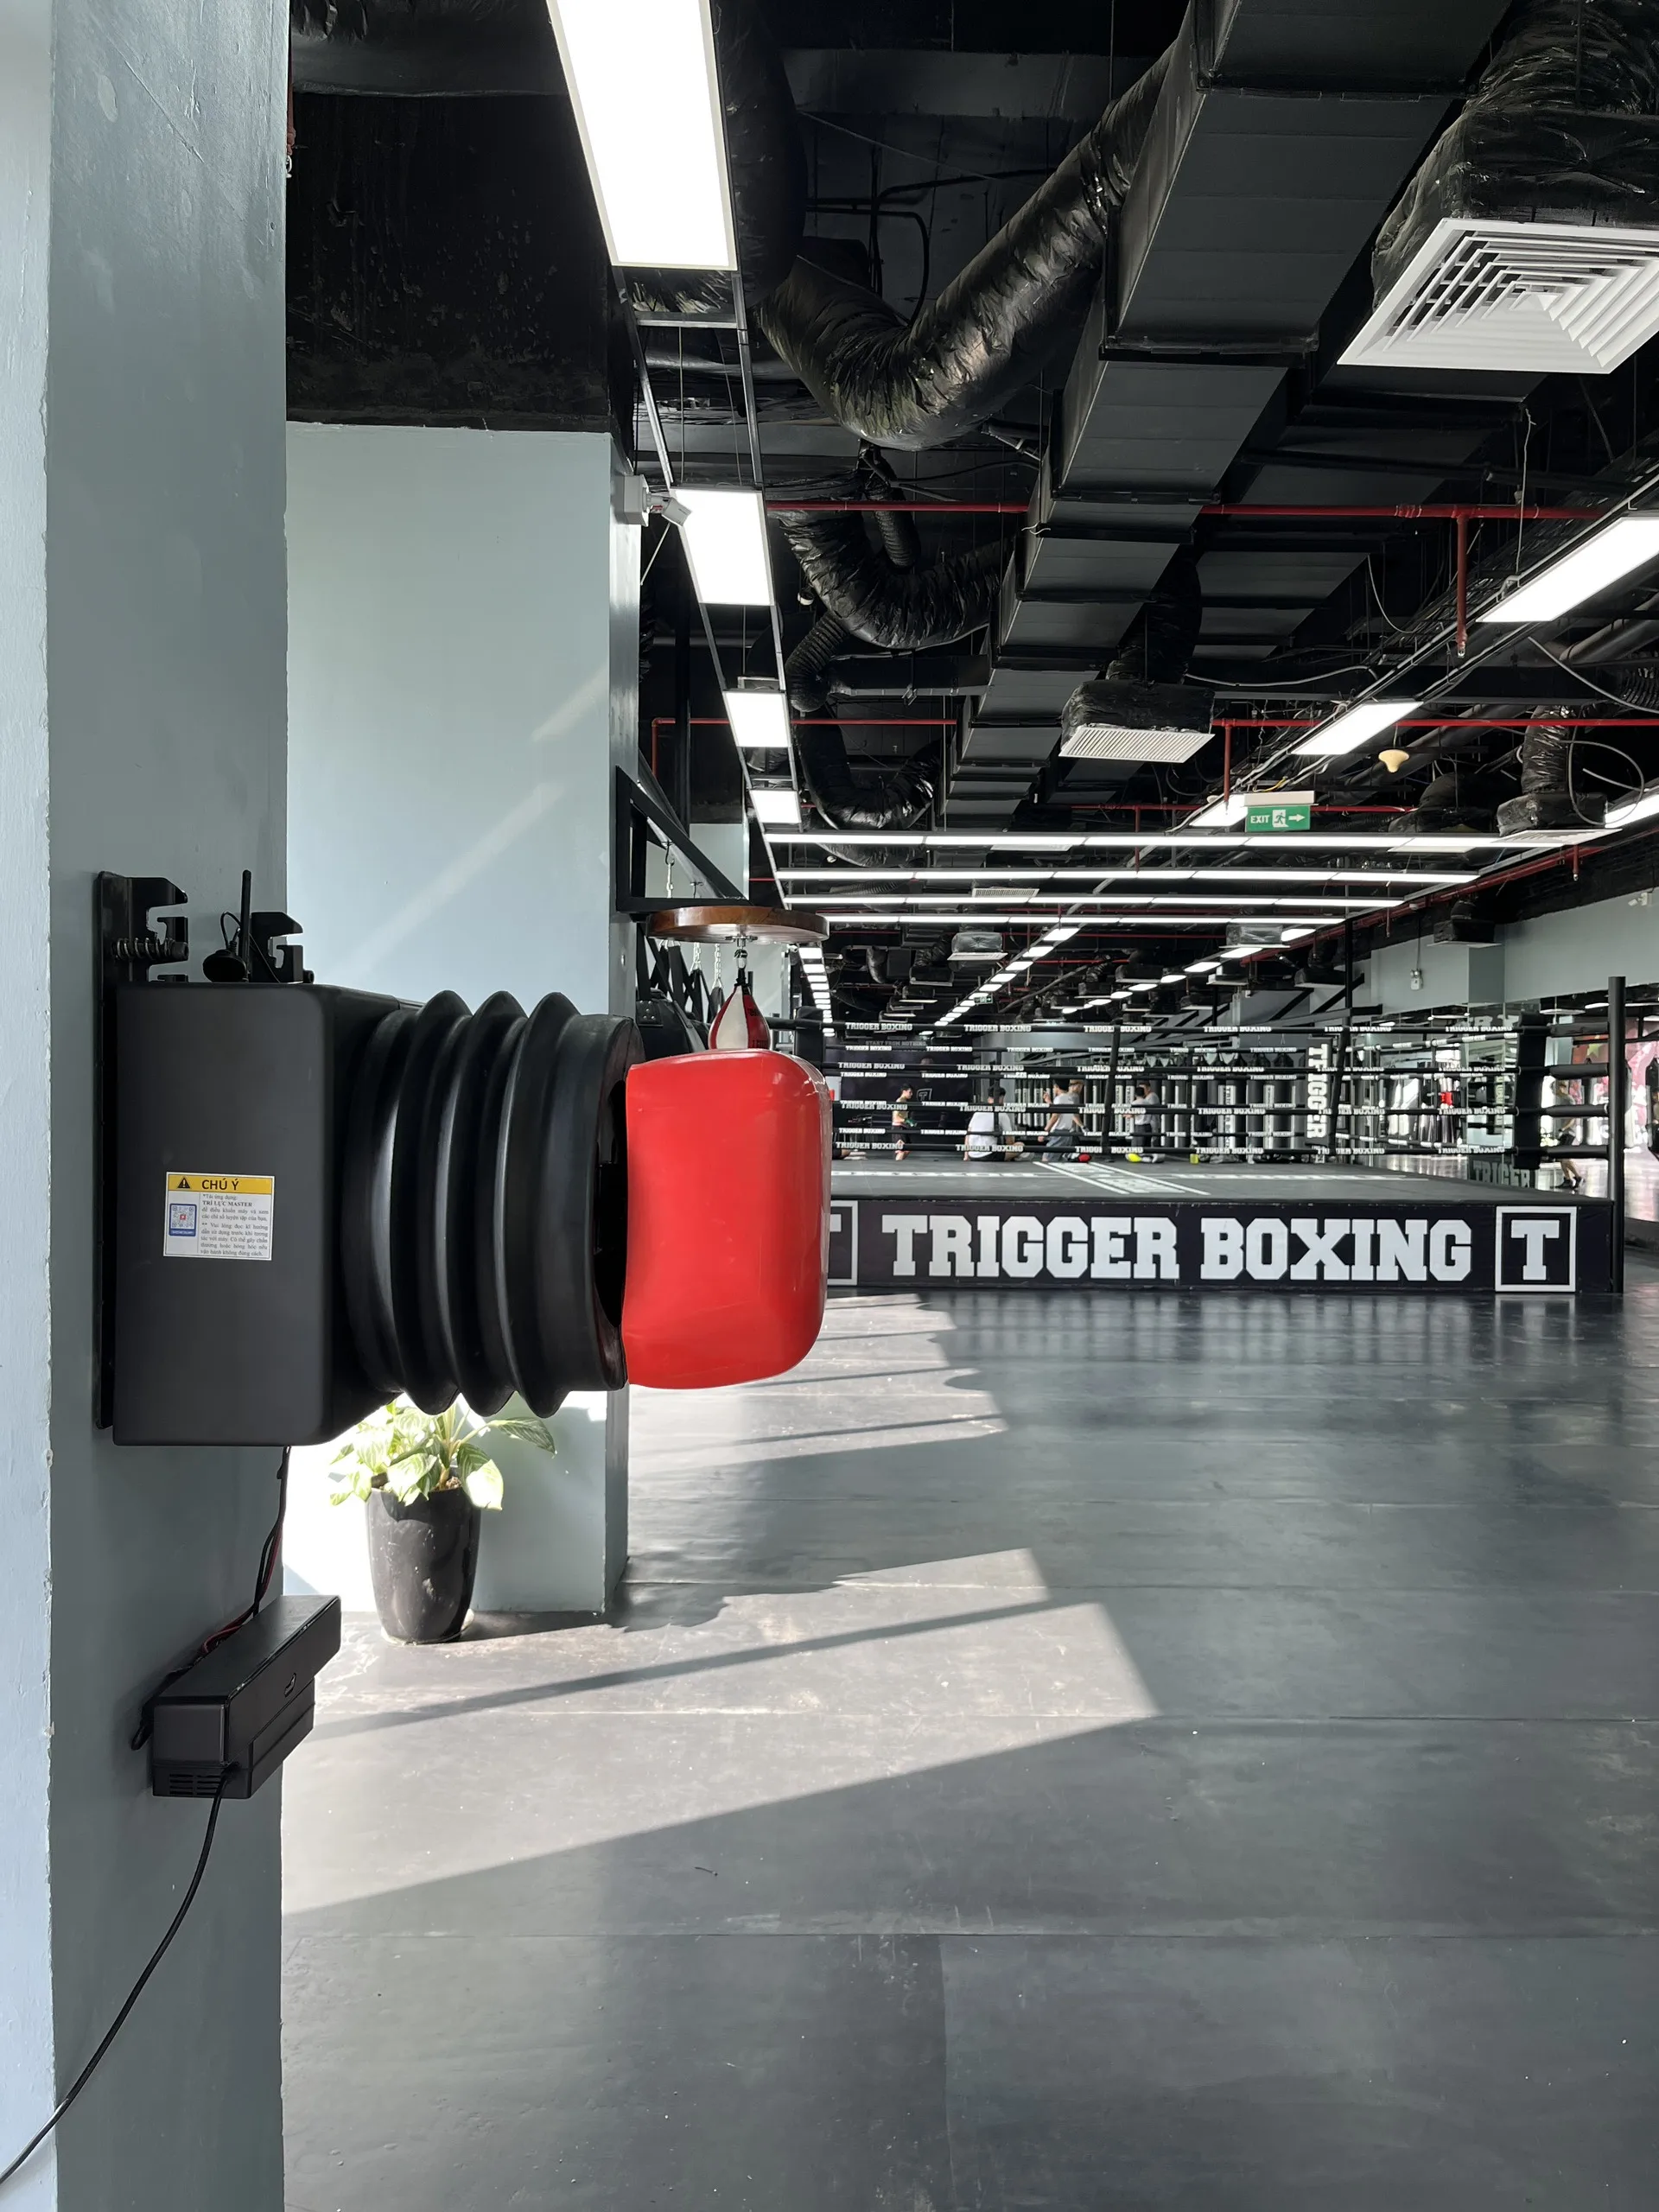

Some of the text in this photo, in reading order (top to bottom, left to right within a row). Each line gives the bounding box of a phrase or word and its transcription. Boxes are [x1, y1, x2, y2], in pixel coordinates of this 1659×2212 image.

[1250, 815, 1271, 823] EXIT
[202, 1178, 239, 1191] CHÚ Ý
[882, 1215, 1472, 1281] TRIGGER BOXING
[1511, 1219, 1560, 1281] T
